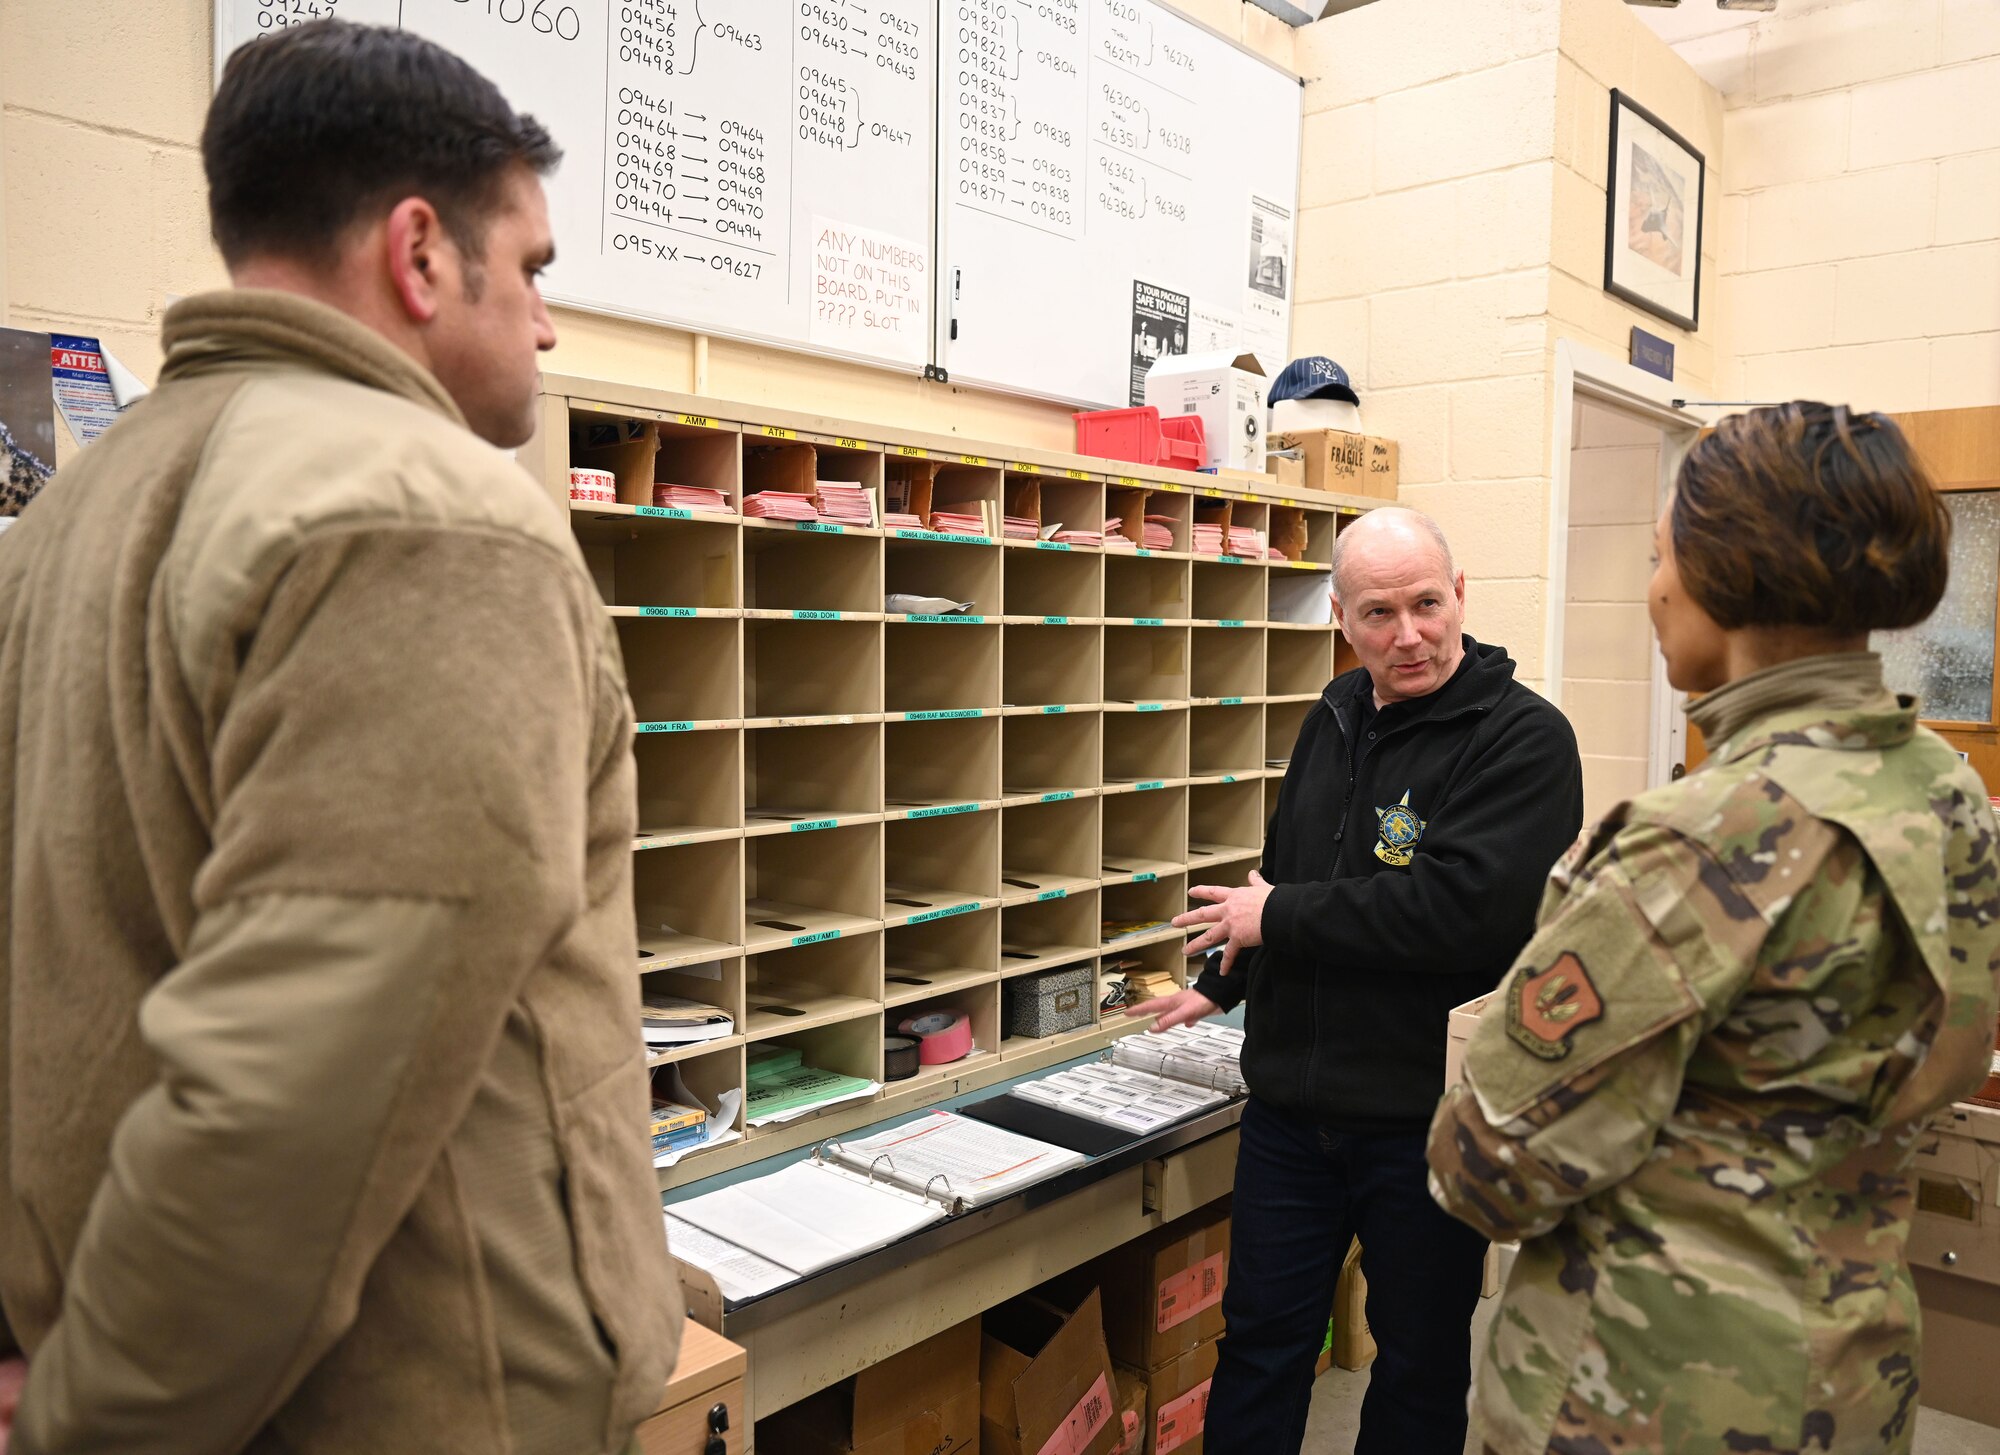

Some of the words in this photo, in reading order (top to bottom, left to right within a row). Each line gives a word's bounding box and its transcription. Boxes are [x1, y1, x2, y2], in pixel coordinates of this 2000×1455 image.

[621, 7, 676, 37] 09456
[623, 0, 677, 20] 454
[959, 7, 1004, 38] 09821
[1038, 5, 1076, 35] 09838
[1105, 0, 1140, 24] 96201
[714, 23, 762, 51] 09463
[801, 3, 848, 31] 09630
[878, 34, 919, 60] 09630
[880, 12, 919, 38] 09627
[620, 27, 675, 56] 09463
[801, 26, 848, 55] 09643
[876, 54, 916, 81] 09643
[959, 28, 1007, 62] 09822
[1104, 40, 1140, 68] 96297
[620, 45, 673, 75] 09498
[959, 48, 1007, 81] 09824
[1037, 51, 1077, 79] 09804
[1163, 44, 1194, 72] 96276
[800, 66, 847, 93] 09645
[959, 71, 1006, 103] 09834
[800, 85, 847, 113] 09647
[959, 92, 1007, 121] 09837
[1102, 84, 1141, 113] 96300
[618, 87, 673, 116] 09461
[720, 120, 764, 145] 09464
[800, 105, 846, 133] 09648
[959, 113, 1007, 142] 09838
[618, 109, 678, 139] 09464
[718, 138, 765, 162] 09464
[799, 125, 844, 152] 09649
[871, 122, 912, 146] 09647
[1034, 121, 1071, 148] 09838
[1101, 121, 1138, 150] 96351
[1159, 128, 1191, 155] 96328
[616, 132, 676, 160] 09468
[717, 160, 766, 183] 09468
[960, 136, 1007, 165] 09858
[1032, 158, 1071, 183] 09803
[1099, 156, 1136, 184] 96362
[616, 152, 673, 179] 09469
[717, 179, 763, 201] 09469
[959, 158, 1005, 184] 09859
[1032, 180, 1070, 203] 09838
[615, 171, 676, 200] 09470
[716, 197, 764, 220] 09470
[959, 179, 1006, 204] 09877
[1030, 201, 1071, 225] 09803
[1099, 193, 1136, 220] 96386
[1154, 195, 1186, 222] 96368
[615, 193, 673, 223] 09494
[715, 218, 762, 242] 09494
[612, 234, 678, 262] 095XX
[710, 255, 762, 280] 09627
[817, 229, 857, 254] ANY
[862, 238, 925, 272] NUMBERS
[818, 254, 849, 275] NOT
[854, 264, 873, 282] ON
[877, 269, 911, 291] THIS
[876, 290, 903, 309] PUT
[908, 299, 920, 314] IN
[1136, 283, 1143, 292] IS
[1143, 285, 1160, 298] YOUR
[1160, 290, 1187, 306] PACKAGE
[1136, 293, 1155, 308] SAFE
[1155, 298, 1166, 311] TO
[1166, 302, 1187, 317] MAIL?
[818, 300, 856, 328] ????
[685, 416, 706, 426] AMM
[768, 427, 785, 437] ATH
[841, 439, 857, 448] AVB
[903, 448, 918, 456] BAH
[1331, 446, 1363, 467] FRAGILE
[965, 457, 978, 465] CTA
[643, 507, 665, 516] 09012
[669, 509, 685, 517] FRA
[802, 523, 821, 532] 09307
[824, 525, 838, 533] BAH
[953, 535, 988, 544] LAKENHEATH
[909, 712, 926, 720] 09469
[939, 710, 978, 718] MOLESWORTH
[929, 808, 941, 816] RAF
[942, 805, 974, 814] ALCONBURY
[797, 822, 815, 831] 09357
[1383, 853, 1400, 864] MPS
[912, 914, 928, 923] 09494
[929, 911, 940, 919] RAF
[941, 903, 976, 917] CROUGHTON
[797, 935, 816, 944] 09463
[821, 932, 834, 940] AMT
